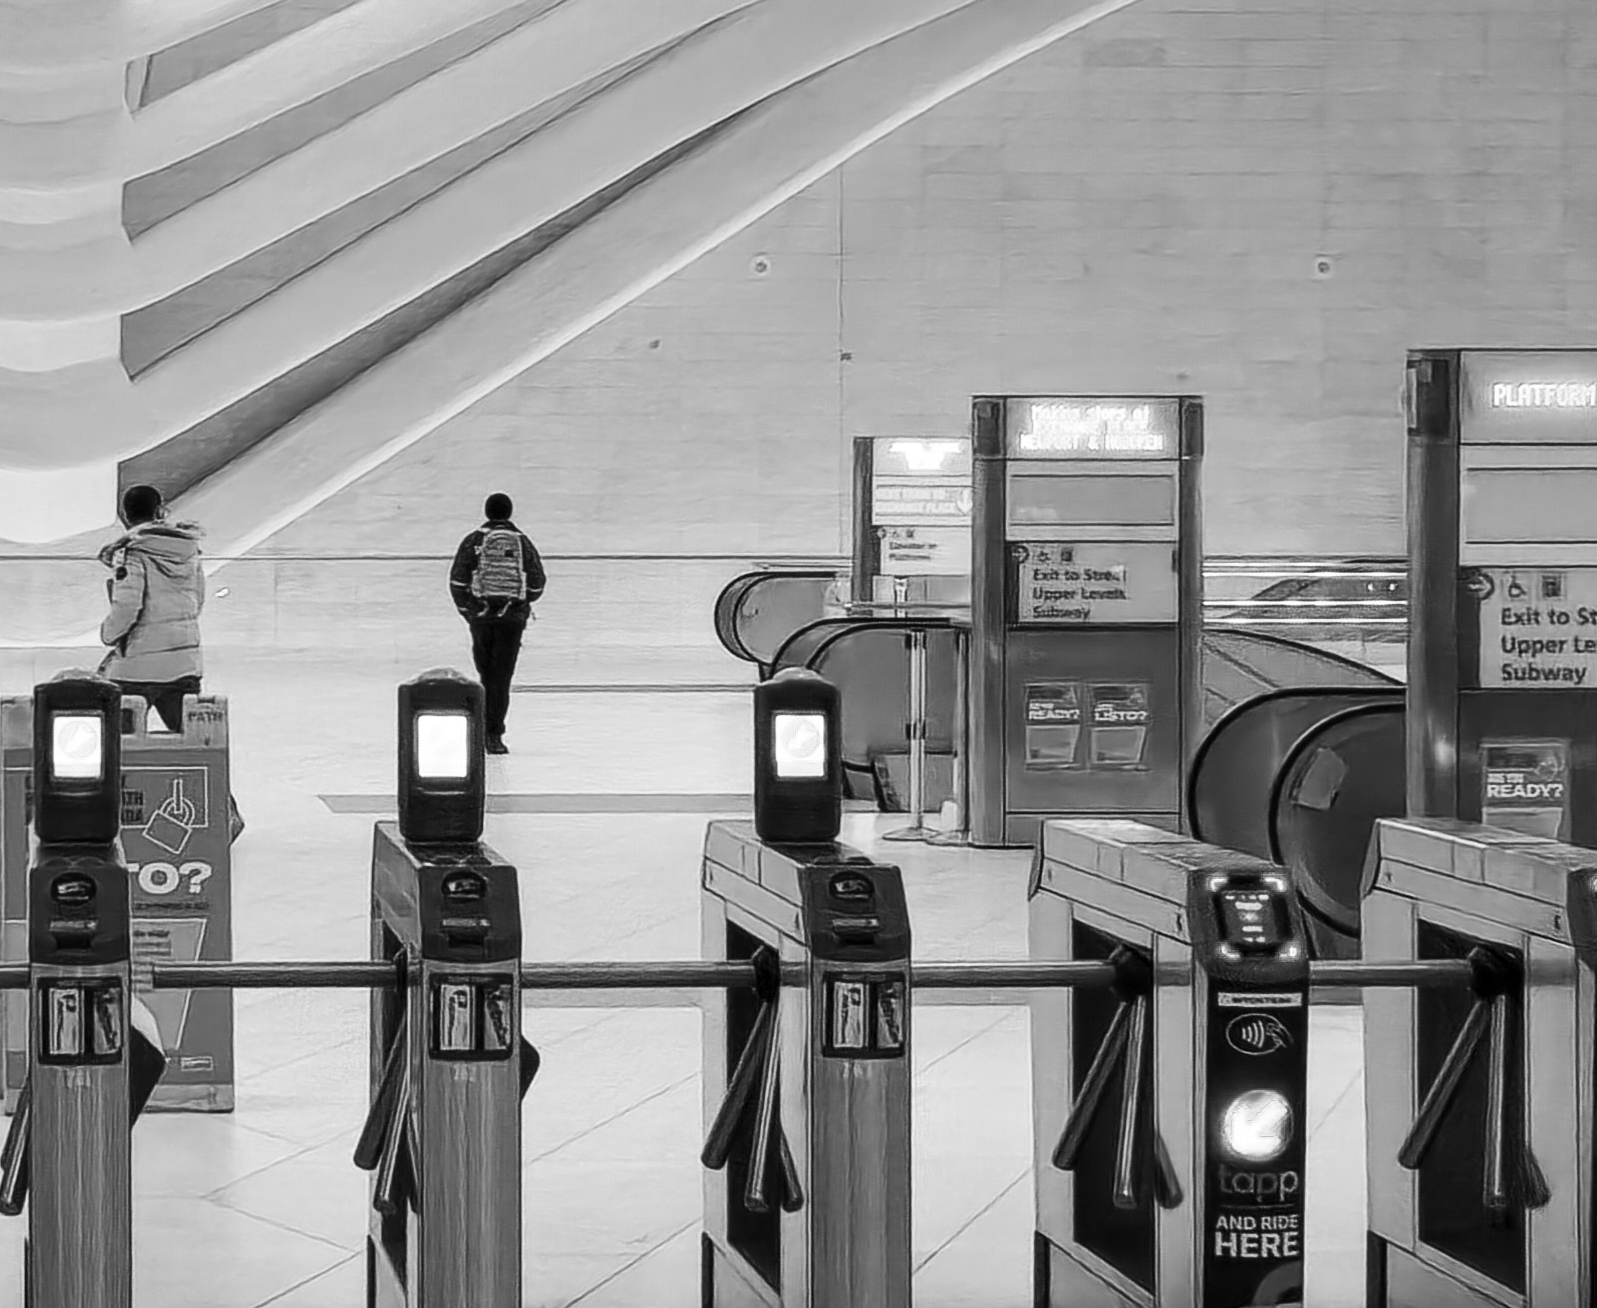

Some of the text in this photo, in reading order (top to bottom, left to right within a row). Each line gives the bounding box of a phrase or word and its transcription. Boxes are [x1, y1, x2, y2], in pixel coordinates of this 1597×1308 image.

[1493, 383, 1597, 407] PLATFORM
[1033, 568, 1059, 582] Exit
[1064, 569, 1080, 582] to
[1033, 586, 1076, 602] Upper
[1033, 605, 1090, 621] Subway
[1501, 607, 1540, 626] Exit
[1548, 608, 1570, 625] to
[1501, 635, 1568, 659] Upper
[1501, 663, 1587, 686] Subway
[1028, 709, 1080, 720] READY?
[1094, 710, 1148, 721] LISTO?
[1487, 783, 1563, 798] READY?
[1219, 1164, 1299, 1202] tapp
[1216, 1214, 1299, 1230] AND RIDE
[1215, 1231, 1300, 1258] HERE
